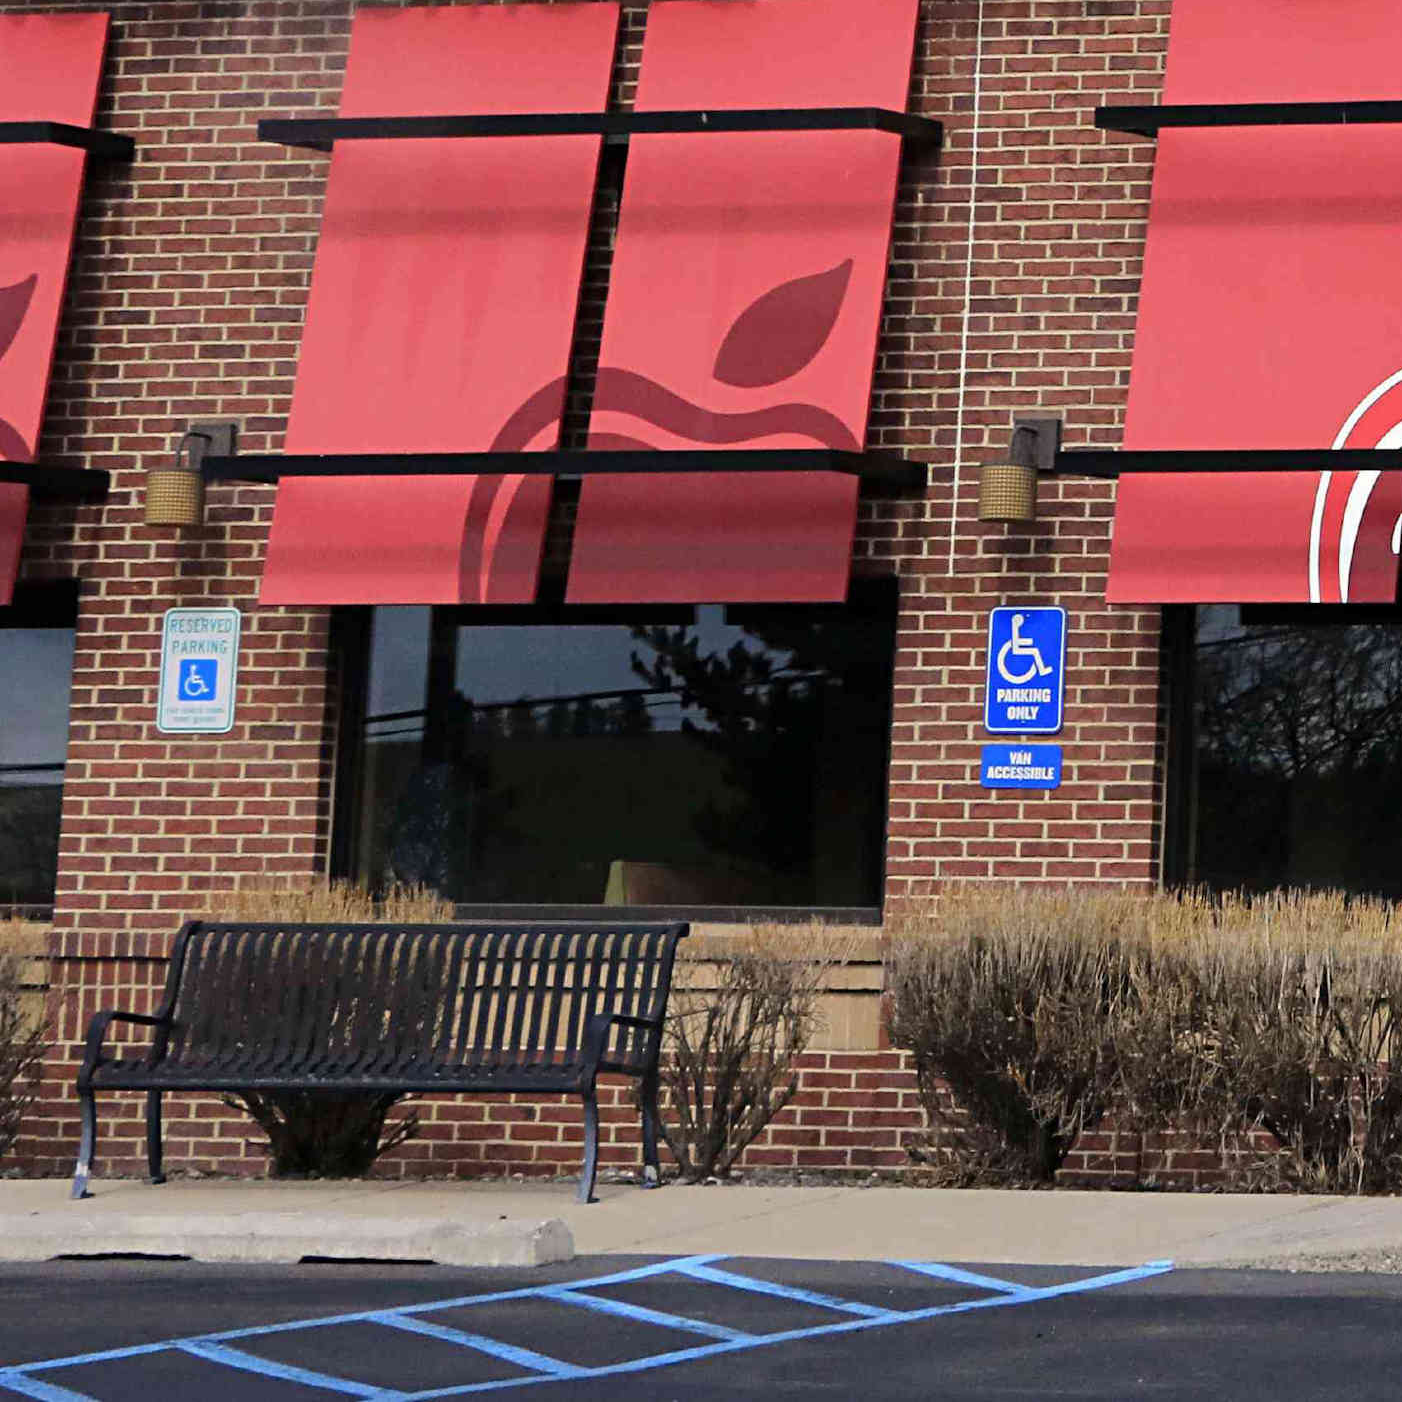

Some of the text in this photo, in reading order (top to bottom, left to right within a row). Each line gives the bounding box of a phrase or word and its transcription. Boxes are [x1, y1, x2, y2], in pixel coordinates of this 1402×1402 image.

[170, 618, 232, 633] RESERVED
[172, 640, 227, 654] PARKING
[997, 688, 1051, 703] PARKING
[1007, 706, 1040, 720] ONLY
[1009, 751, 1032, 765] VAN
[986, 766, 1055, 780] ACCESSIBLE
